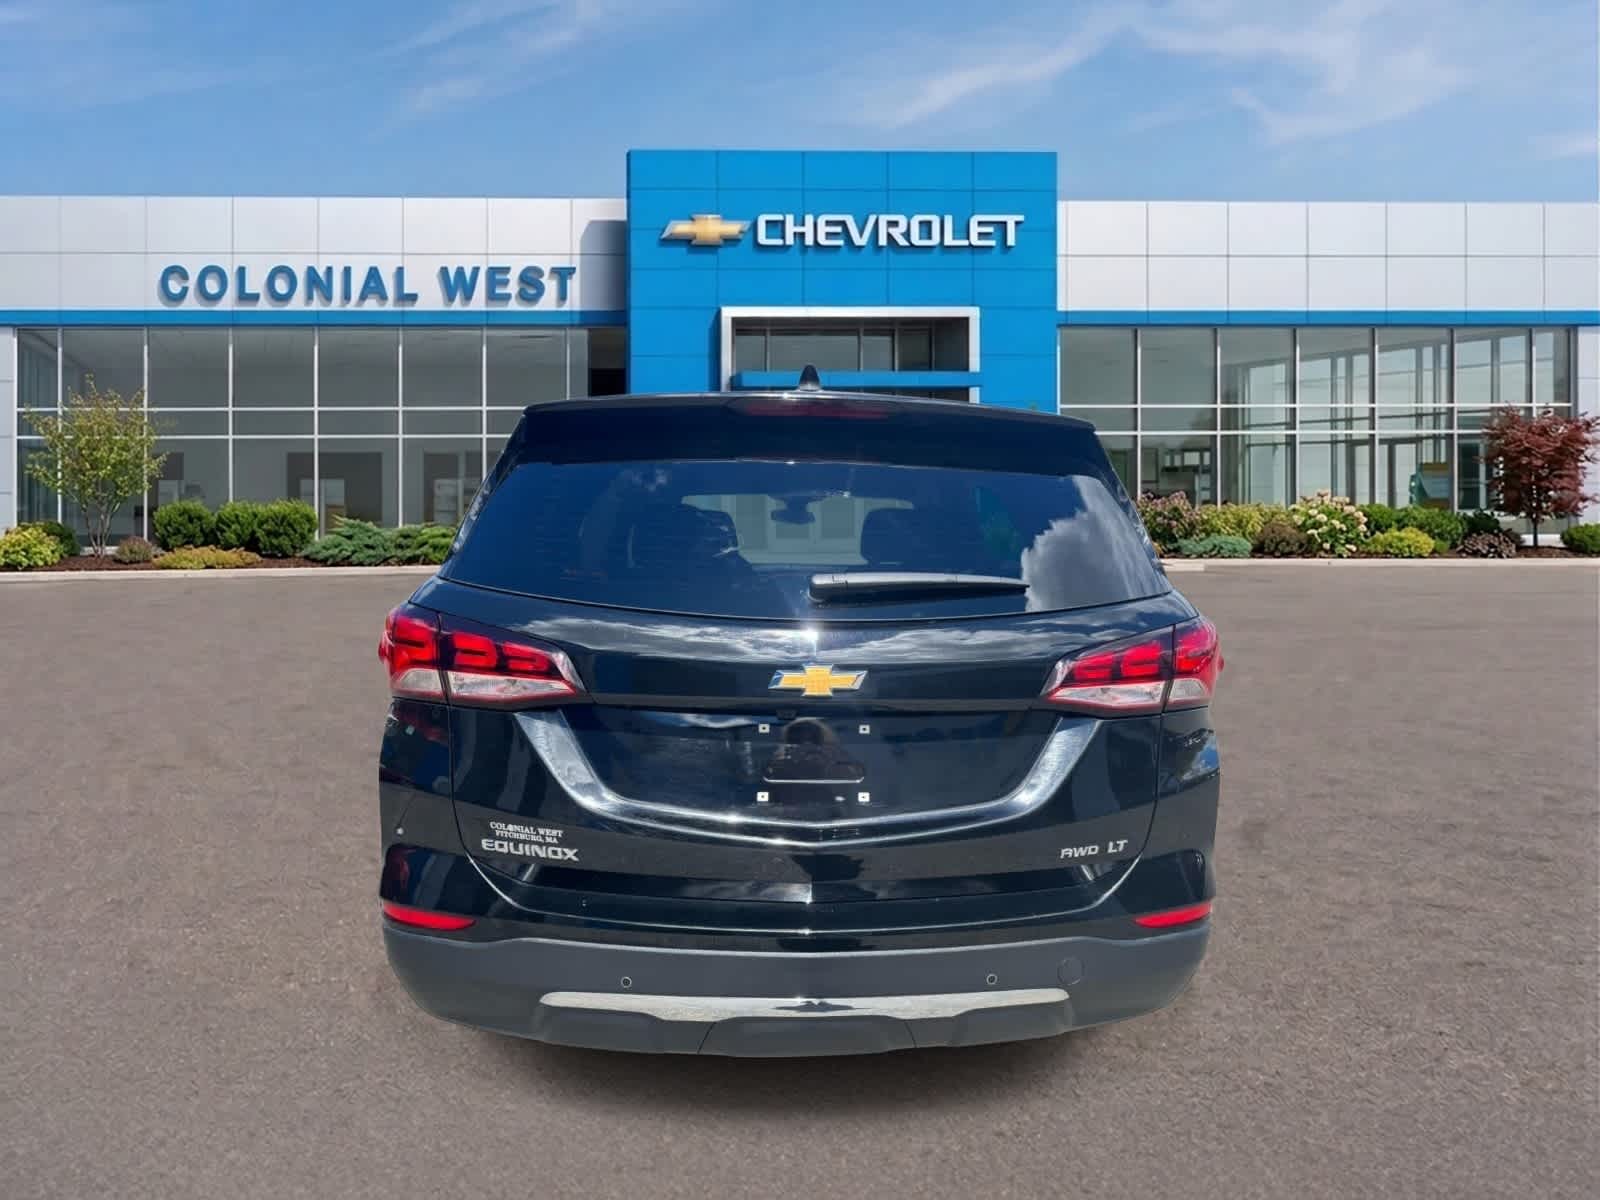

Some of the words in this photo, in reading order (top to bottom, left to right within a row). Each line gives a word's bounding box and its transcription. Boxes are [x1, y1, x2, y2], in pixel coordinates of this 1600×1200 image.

[757, 213, 1024, 247] CHEVROLET
[160, 265, 419, 306] COLONIAL
[437, 265, 577, 306] WEST
[490, 821, 537, 835] COLONIAL
[537, 827, 564, 838] WEST
[545, 836, 559, 844] MA
[481, 838, 580, 862] EQUINOX
[1060, 845, 1099, 859] AWD
[1107, 839, 1128, 853] LT
